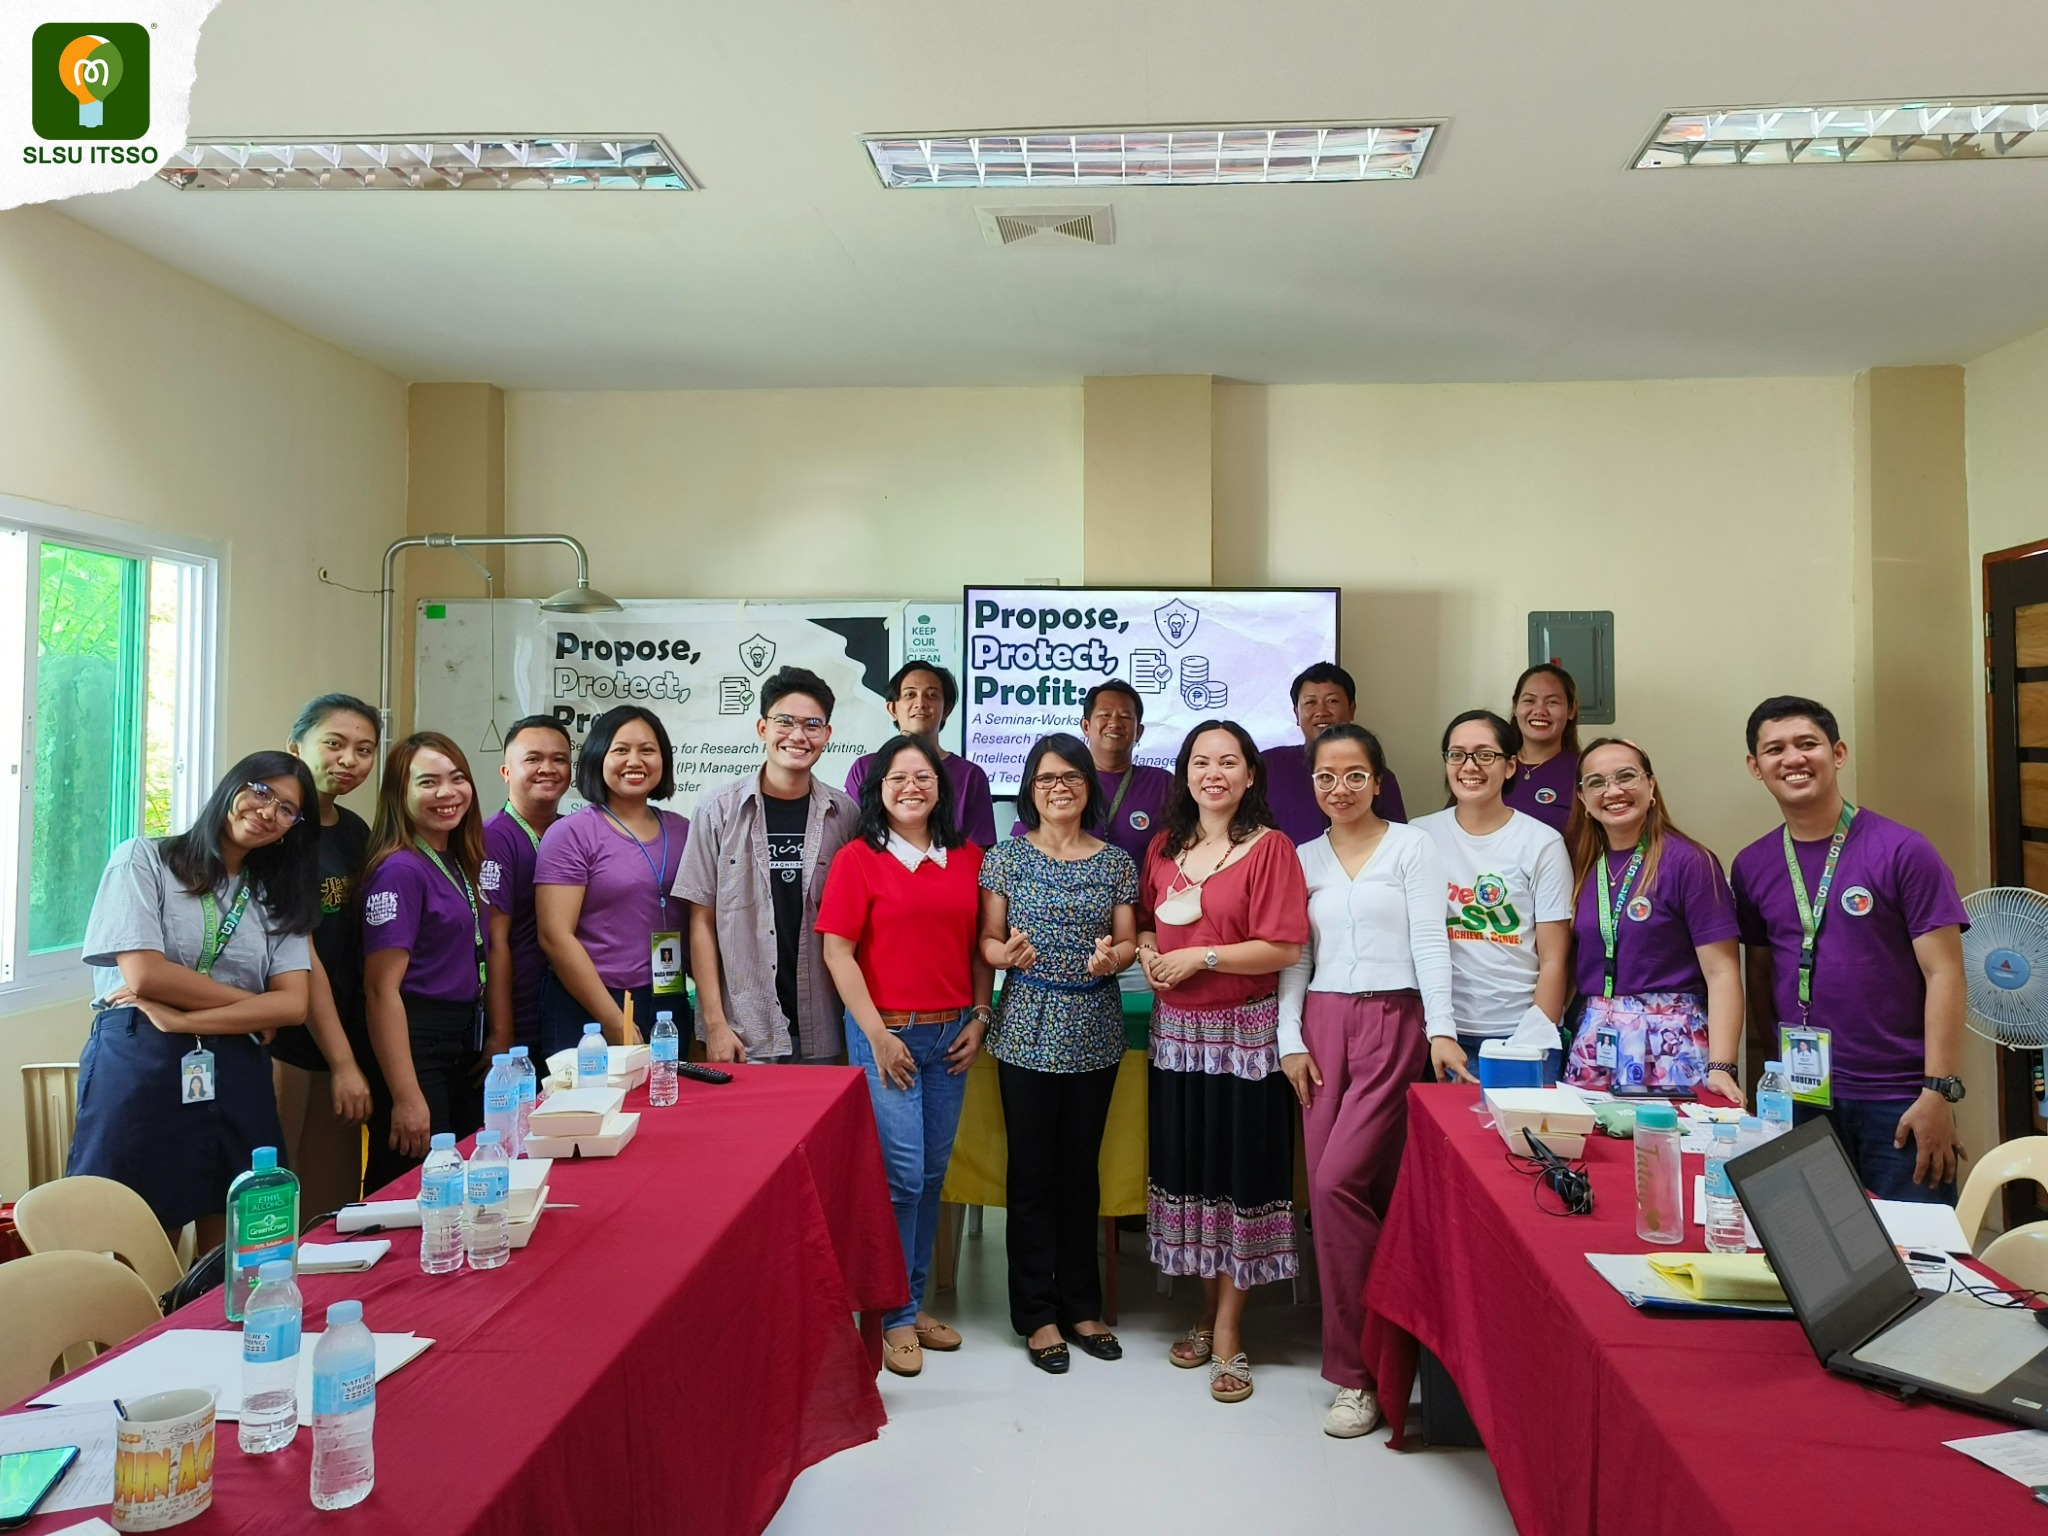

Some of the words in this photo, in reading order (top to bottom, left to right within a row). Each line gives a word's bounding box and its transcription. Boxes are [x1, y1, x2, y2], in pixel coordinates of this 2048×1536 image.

[975, 600, 1129, 635] Propose,
[912, 627, 937, 636] KEEP
[555, 632, 701, 666] Propose,
[913, 638, 935, 647] OUR
[972, 635, 1119, 676] Protect,
[554, 667, 691, 704] Protect,
[974, 676, 1087, 705] Profit:
[972, 714, 982, 725] A
[985, 713, 1080, 726] Seminar-Works
[972, 732, 1031, 744] Research
[681, 743, 698, 754] for
[700, 743, 759, 754] Research
[676, 762, 697, 775] (IP)
[699, 762, 761, 775] Managem
[258, 1194, 281, 1203] ETHYL
[252, 1200, 286, 1211] ALCOHOL
